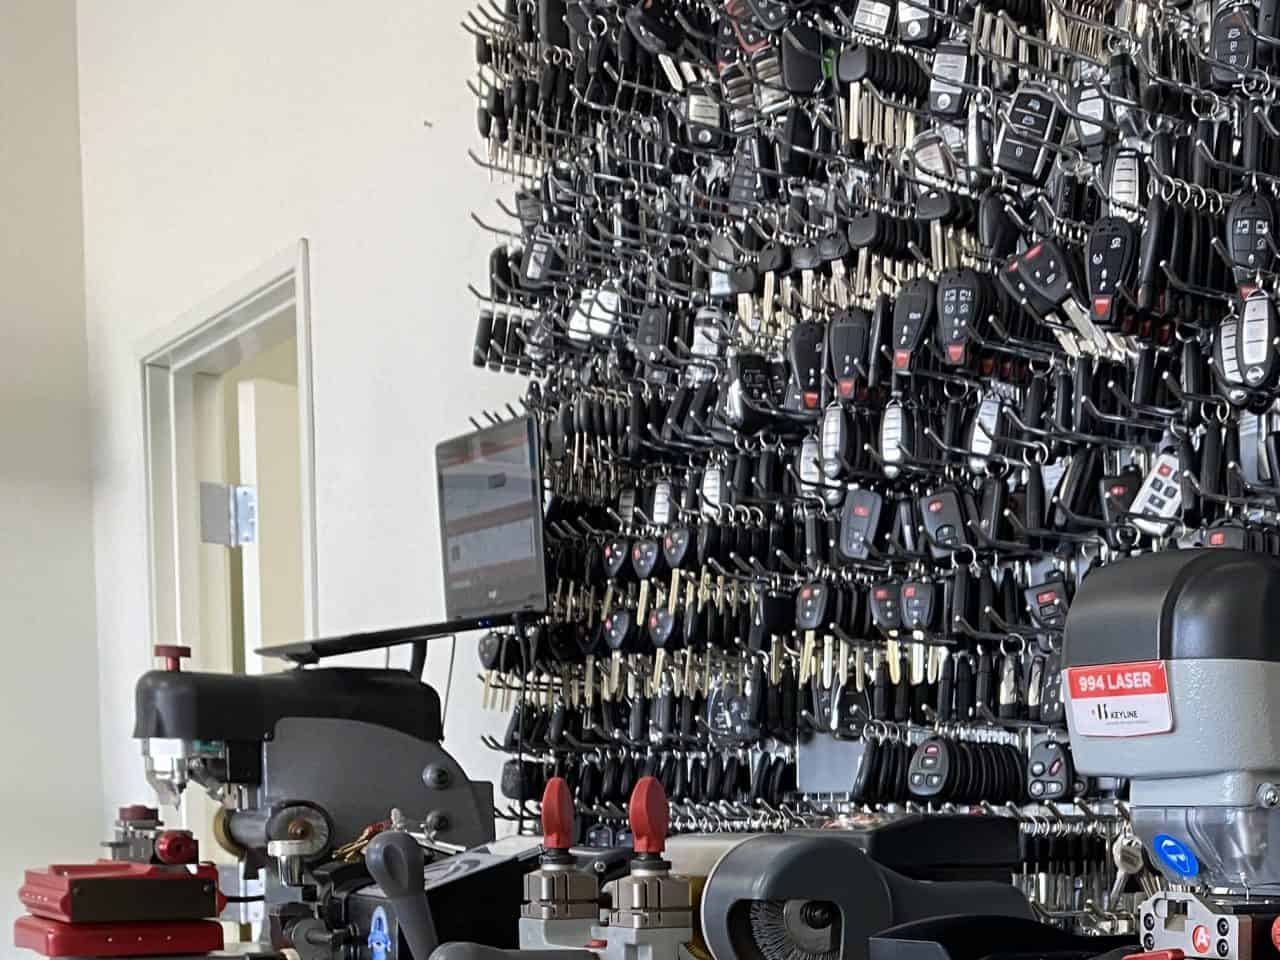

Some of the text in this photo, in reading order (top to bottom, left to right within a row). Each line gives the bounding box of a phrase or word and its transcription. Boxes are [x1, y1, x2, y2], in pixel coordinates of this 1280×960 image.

[1078, 671, 1153, 692] 994 LASER
[1110, 710, 1139, 719] KEYLINE
